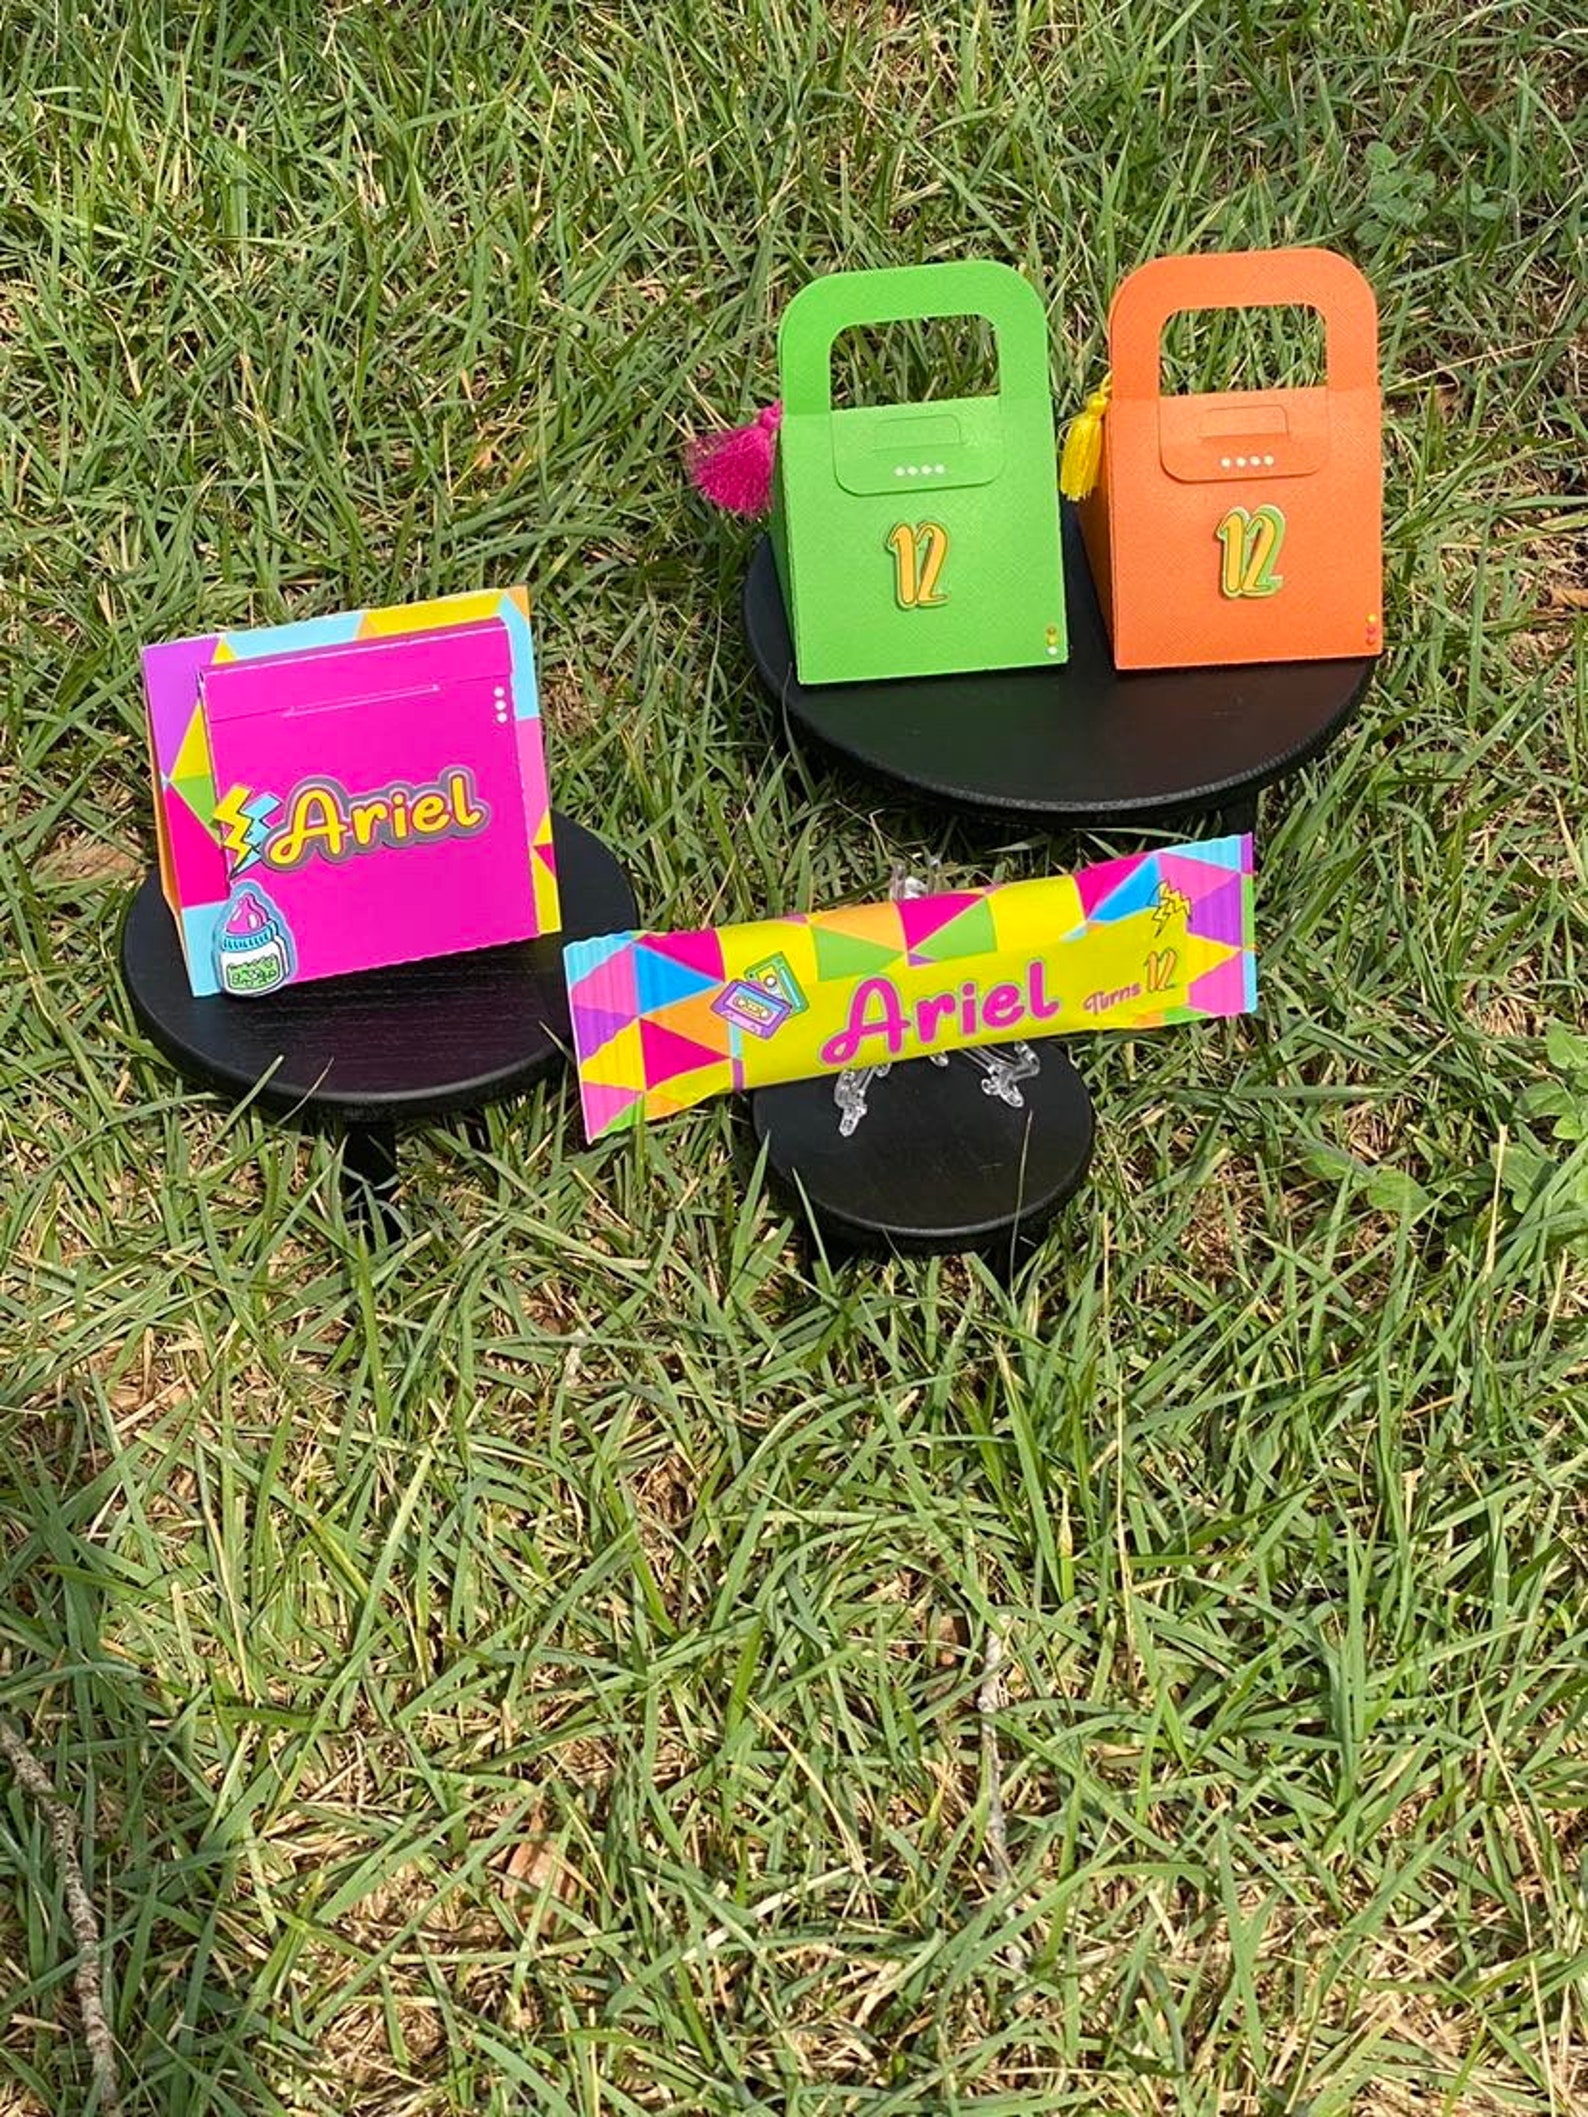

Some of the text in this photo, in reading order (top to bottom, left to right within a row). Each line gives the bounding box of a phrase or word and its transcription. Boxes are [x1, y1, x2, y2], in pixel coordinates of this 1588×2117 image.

[887, 521, 950, 610] 12
[1217, 506, 1285, 598] 12
[267, 773, 487, 867] Ariel
[821, 961, 1060, 1066] Ariel
[1083, 948, 1177, 1015] Turns 12
